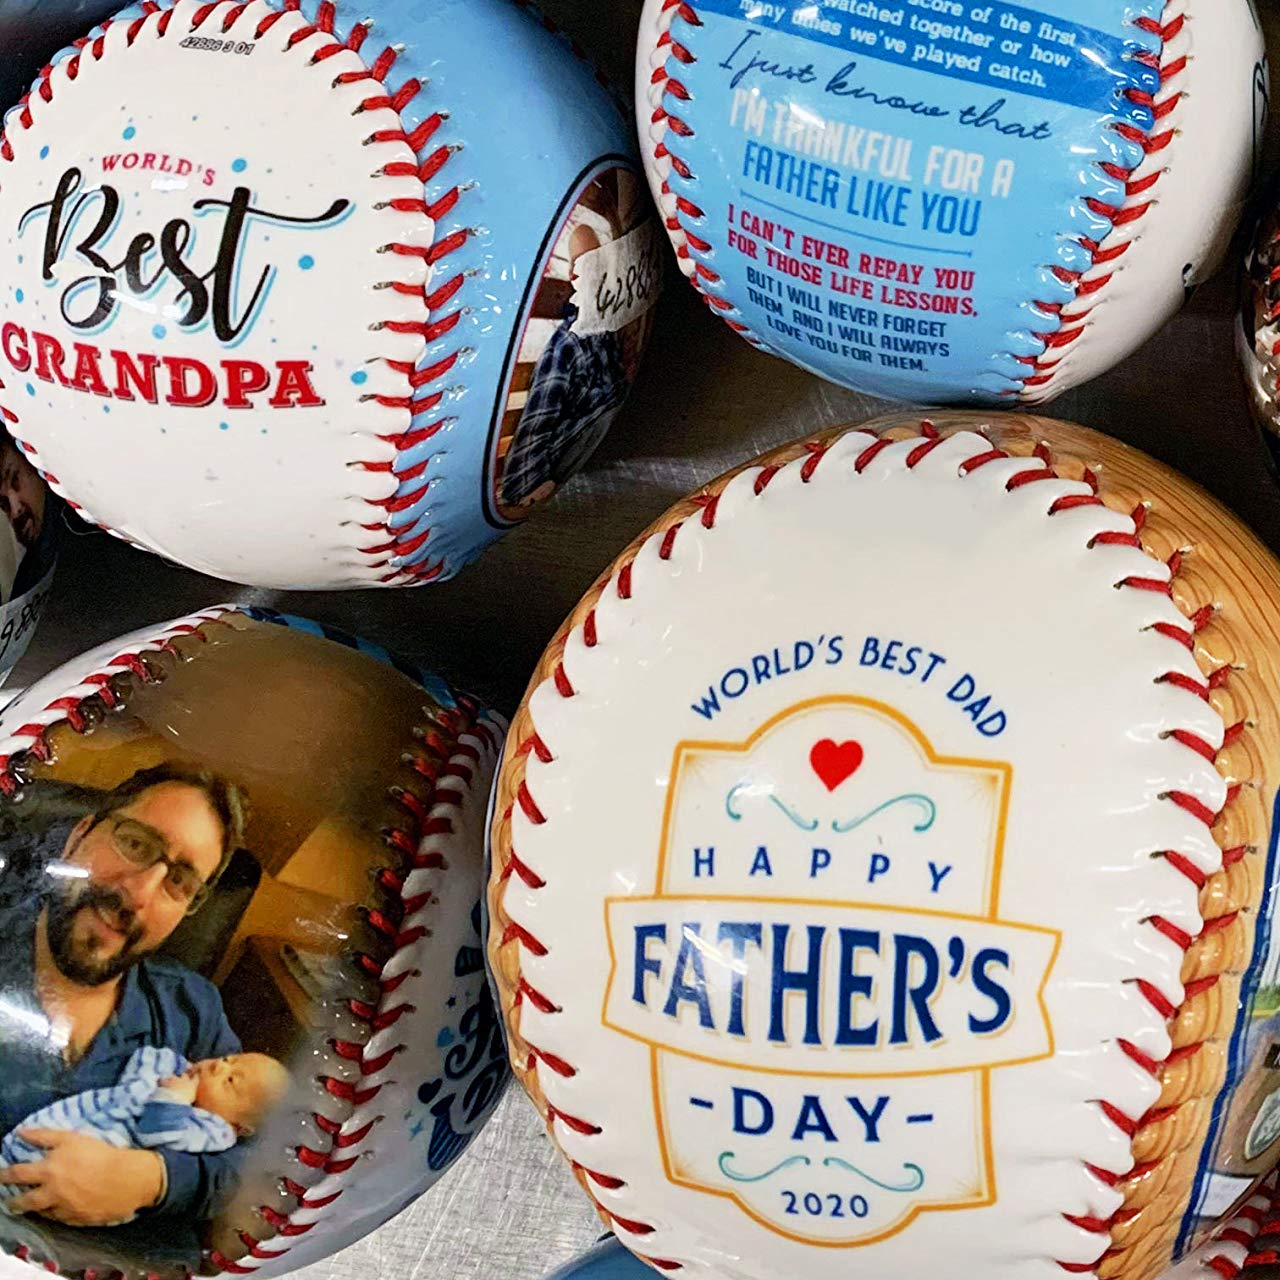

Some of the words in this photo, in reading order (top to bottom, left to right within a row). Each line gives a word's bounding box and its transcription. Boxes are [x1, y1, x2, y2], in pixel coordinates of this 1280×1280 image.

[718, 29, 761, 71] I
[849, 24, 907, 54] we've
[914, 40, 982, 73] played
[987, 60, 1048, 89] catch.
[909, 12, 995, 50] together
[1000, 35, 1023, 55] or
[1030, 41, 1072, 69] how
[970, 5, 993, 24] of
[1000, 12, 1031, 36] the
[1036, 20, 1077, 48] first
[730, 48, 817, 90] just
[824, 60, 950, 119] know
[729, 87, 766, 137] I'M
[772, 98, 912, 182] THANKFUL
[924, 145, 983, 194] FOR
[991, 158, 1015, 199] A
[958, 98, 1055, 141] that
[101, 152, 216, 186] WORLD'S
[742, 140, 839, 209] FATHER
[847, 175, 911, 227] LIKE
[921, 191, 982, 237] YOU
[18, 166, 354, 348] Best
[727, 203, 734, 223] I
[740, 209, 796, 250] CAN'T
[802, 235, 849, 269] EVER
[859, 253, 924, 286] REPAY
[933, 268, 976, 291] YOU
[727, 228, 758, 260] FOR
[764, 246, 823, 286] THOSE
[830, 271, 874, 300] LIFE
[746, 266, 774, 291] BUT
[776, 278, 783, 297] I
[786, 283, 822, 314] WILL
[828, 299, 879, 327] NEVER
[882, 313, 947, 338] FORGET
[746, 287, 785, 317] THEM
[792, 309, 824, 333] AND
[827, 322, 833, 336] I
[839, 324, 877, 348] WILL
[881, 333, 950, 357] ALWAYS
[2, 322, 325, 410] GRANDPA
[766, 315, 803, 342] LOVE
[806, 331, 839, 354] YOU
[841, 343, 873, 363] FOR
[690, 636, 843, 721] WORLD'S
[859, 637, 946, 683] BEST
[946, 677, 1008, 738] DAD
[694, 847, 953, 895] HAPPY
[631, 923, 1013, 1049] FATHER'S
[780, 1189, 870, 1220] 2020
